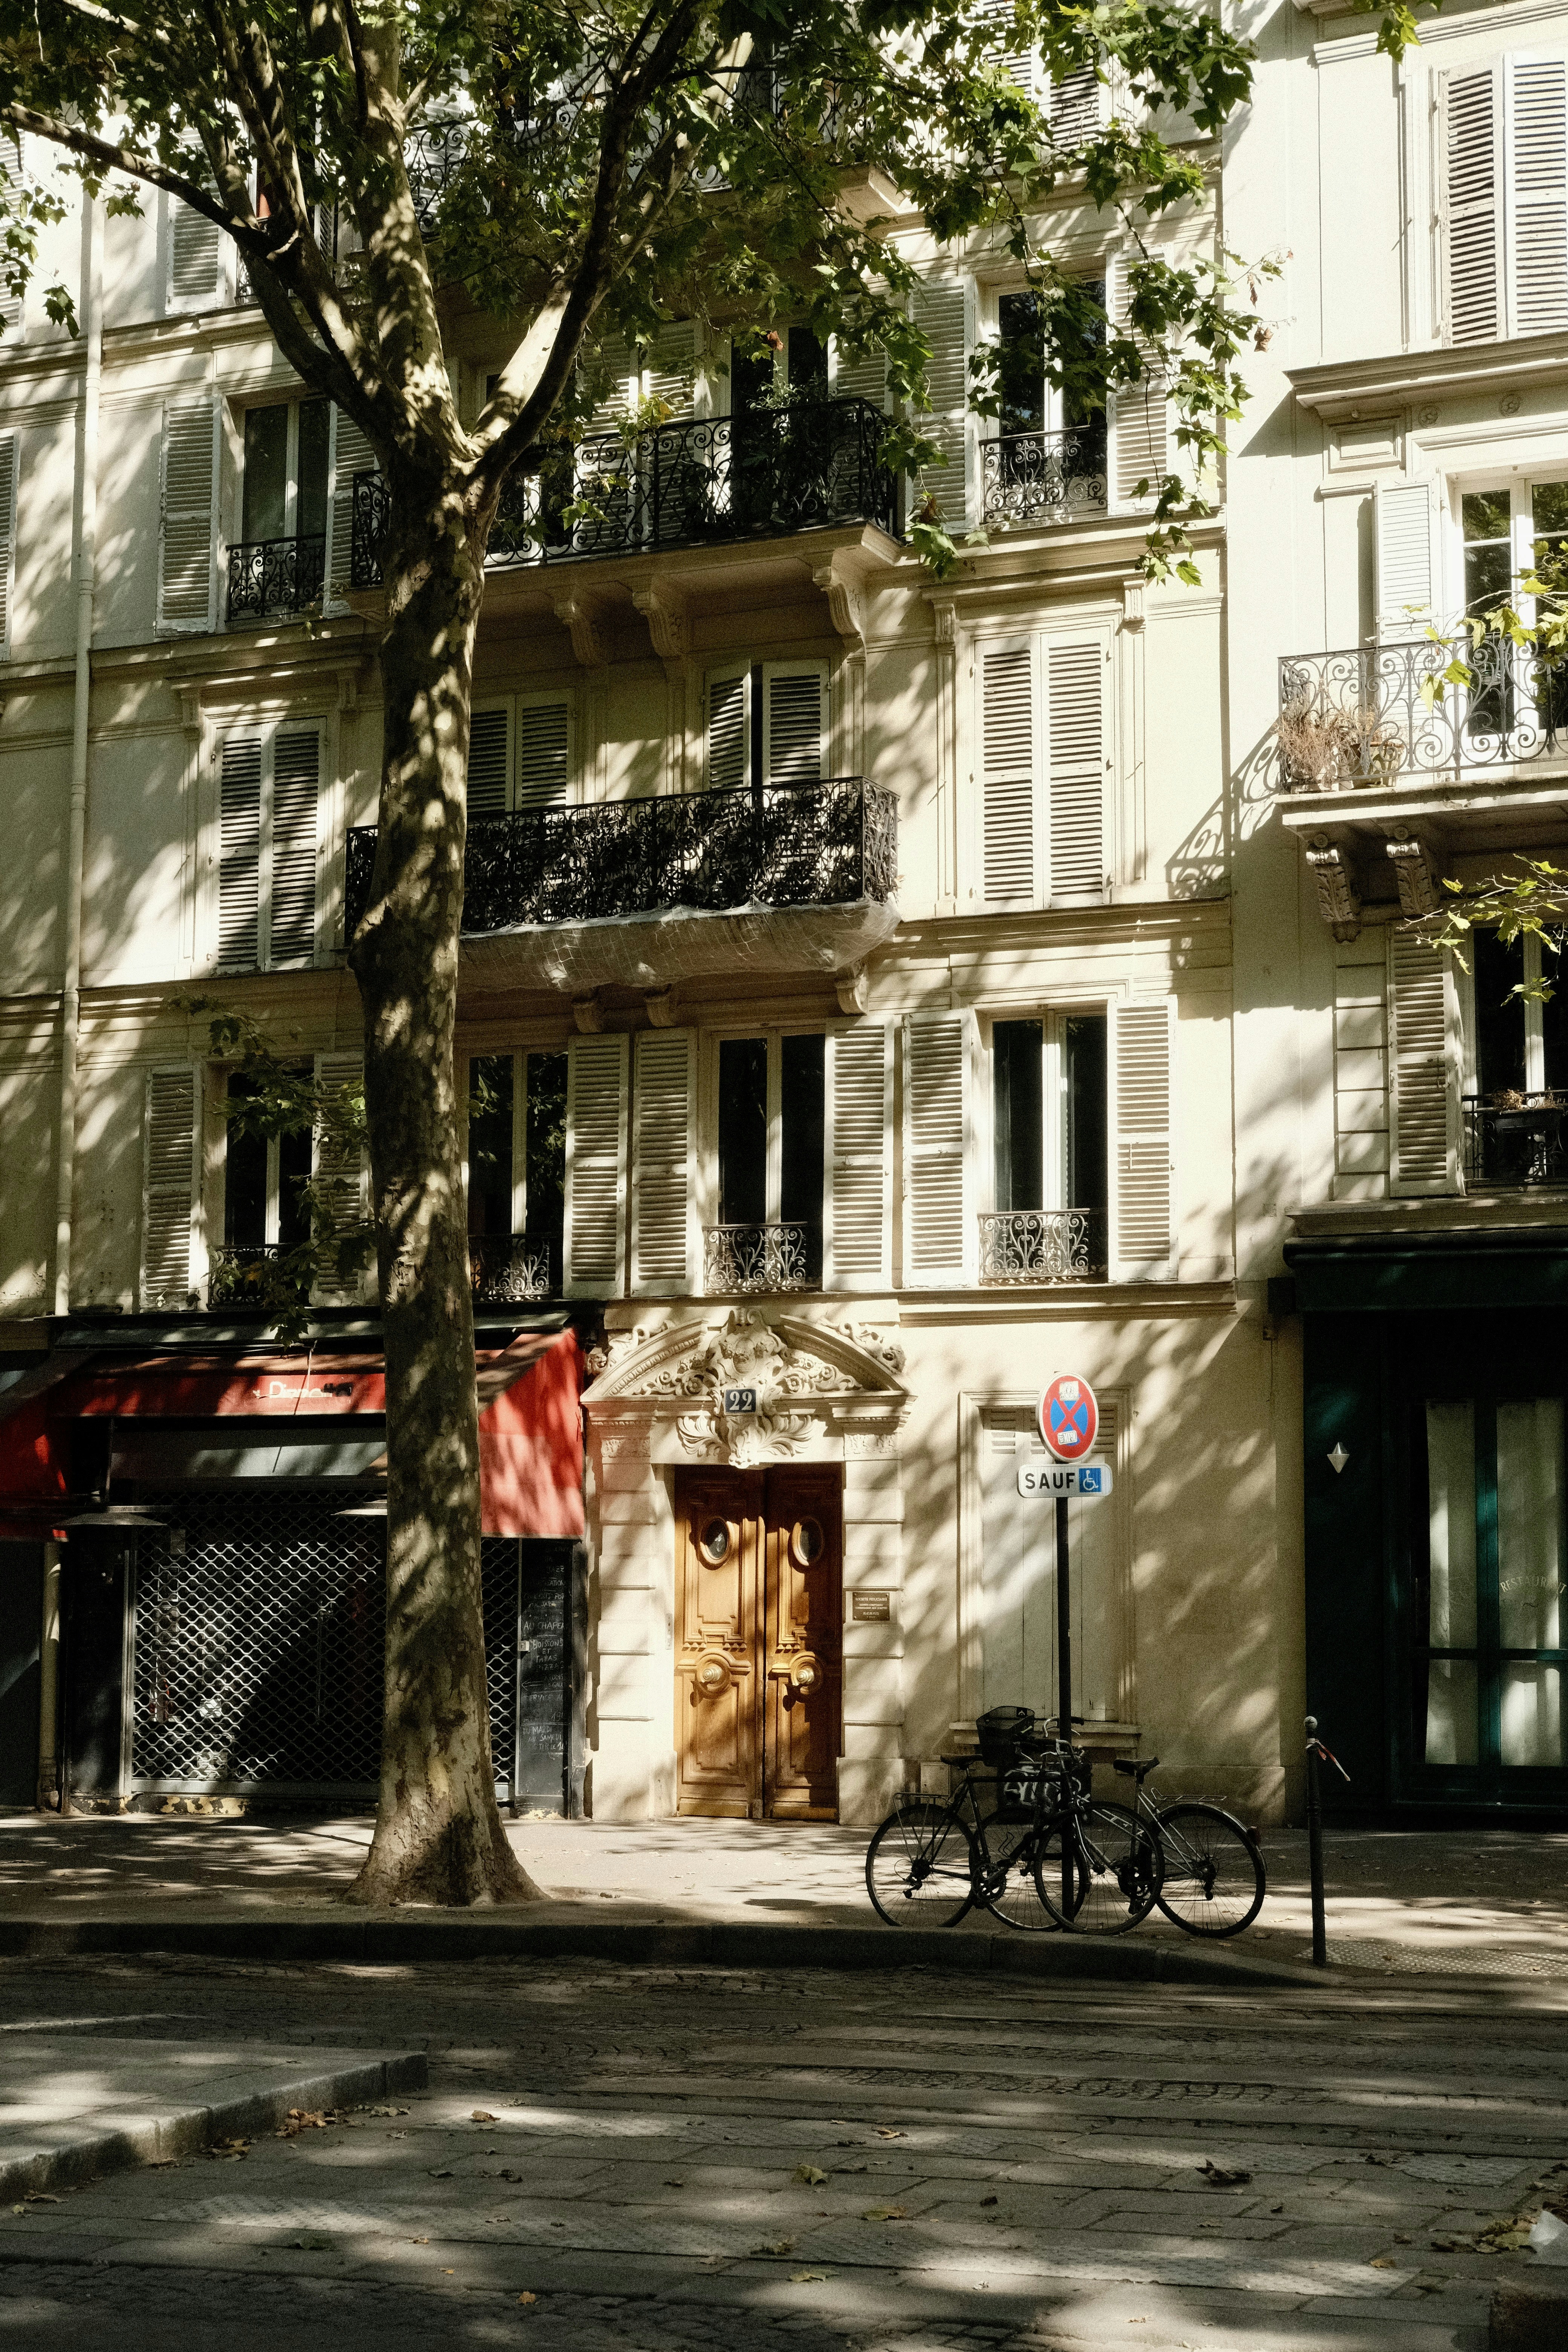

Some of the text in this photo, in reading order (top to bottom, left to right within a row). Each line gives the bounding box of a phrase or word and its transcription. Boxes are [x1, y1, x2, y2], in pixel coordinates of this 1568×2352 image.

[729, 1391, 752, 1410] 22
[1025, 1472, 1075, 1490] SAUF
[533, 1725, 552, 1734] MARDI
[539, 1733, 561, 1743] SAMEDI
